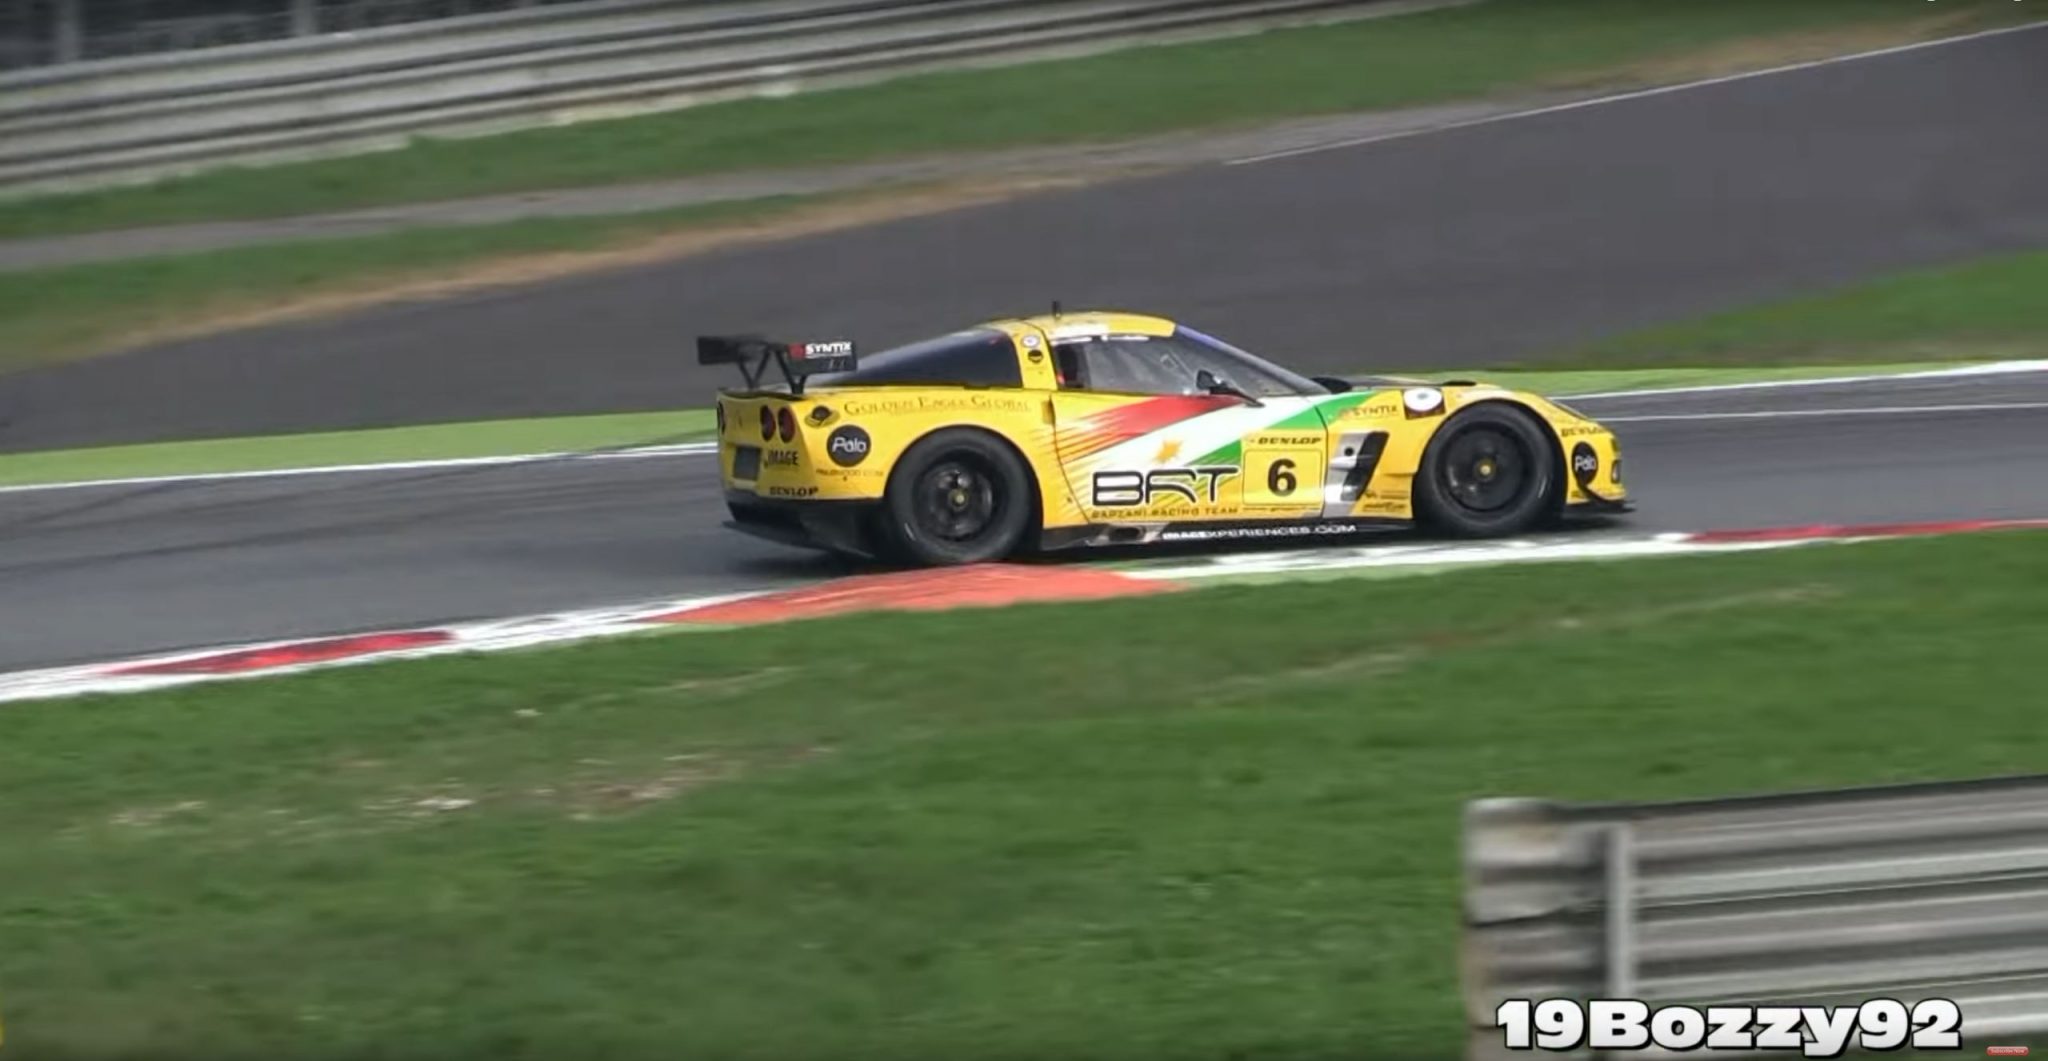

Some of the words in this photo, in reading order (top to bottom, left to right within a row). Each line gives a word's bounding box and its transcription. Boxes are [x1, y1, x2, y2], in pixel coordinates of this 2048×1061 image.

[805, 341, 852, 355] SYNTIX
[970, 394, 1031, 412] GLOBAL
[832, 437, 867, 453] Palo
[1257, 437, 1322, 445] DUNLOP
[1267, 458, 1297, 497] 6
[769, 486, 818, 497] DUNLOP
[1092, 467, 1239, 506] BRT
